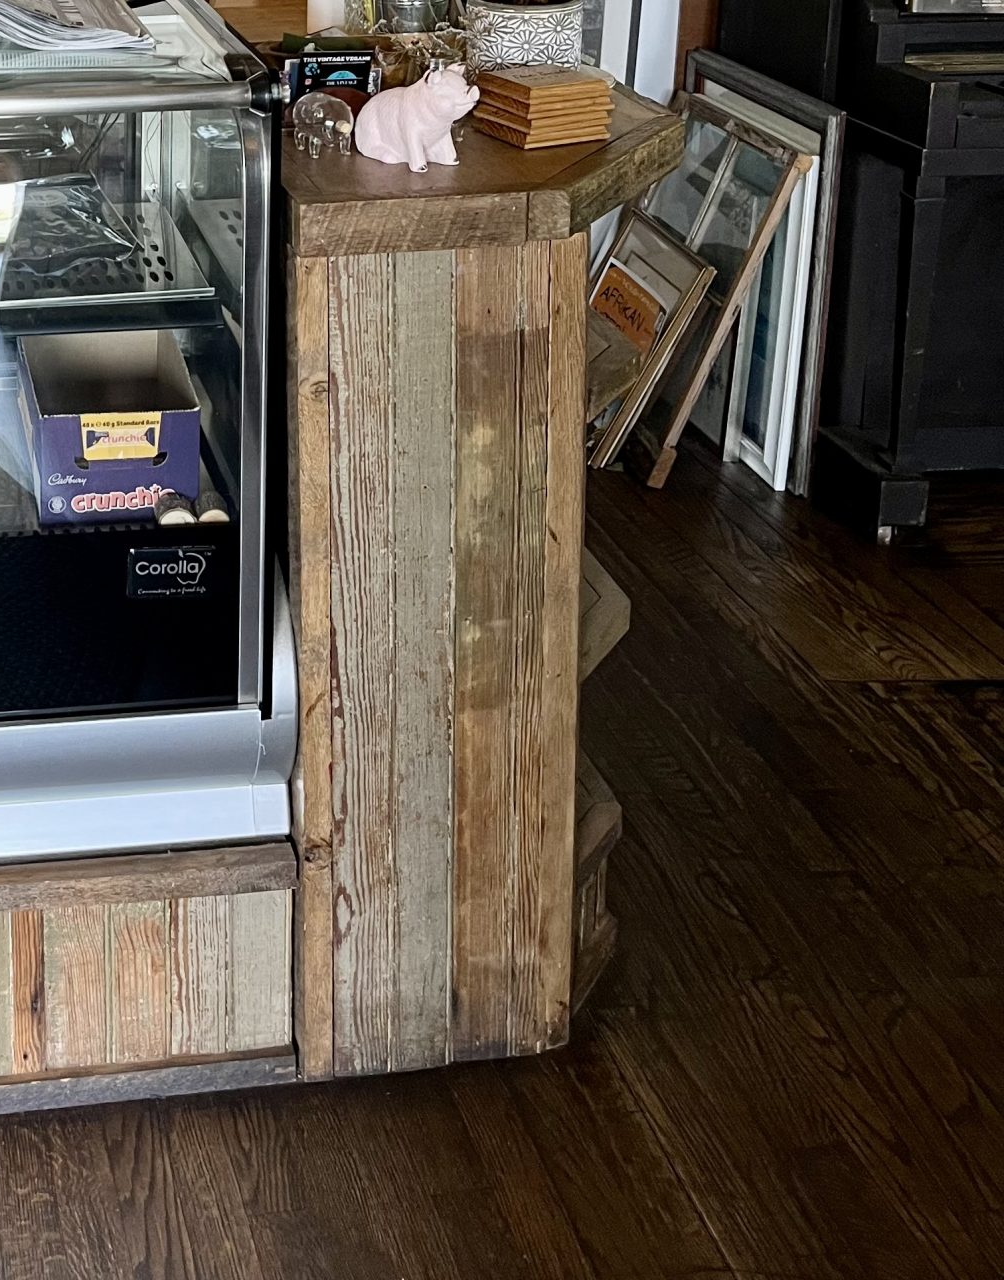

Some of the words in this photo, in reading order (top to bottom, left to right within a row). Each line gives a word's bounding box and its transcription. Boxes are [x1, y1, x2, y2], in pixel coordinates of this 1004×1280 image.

[102, 434, 147, 444] crunchie
[48, 472, 87, 486] Cadbury
[135, 560, 199, 576] Corolla
